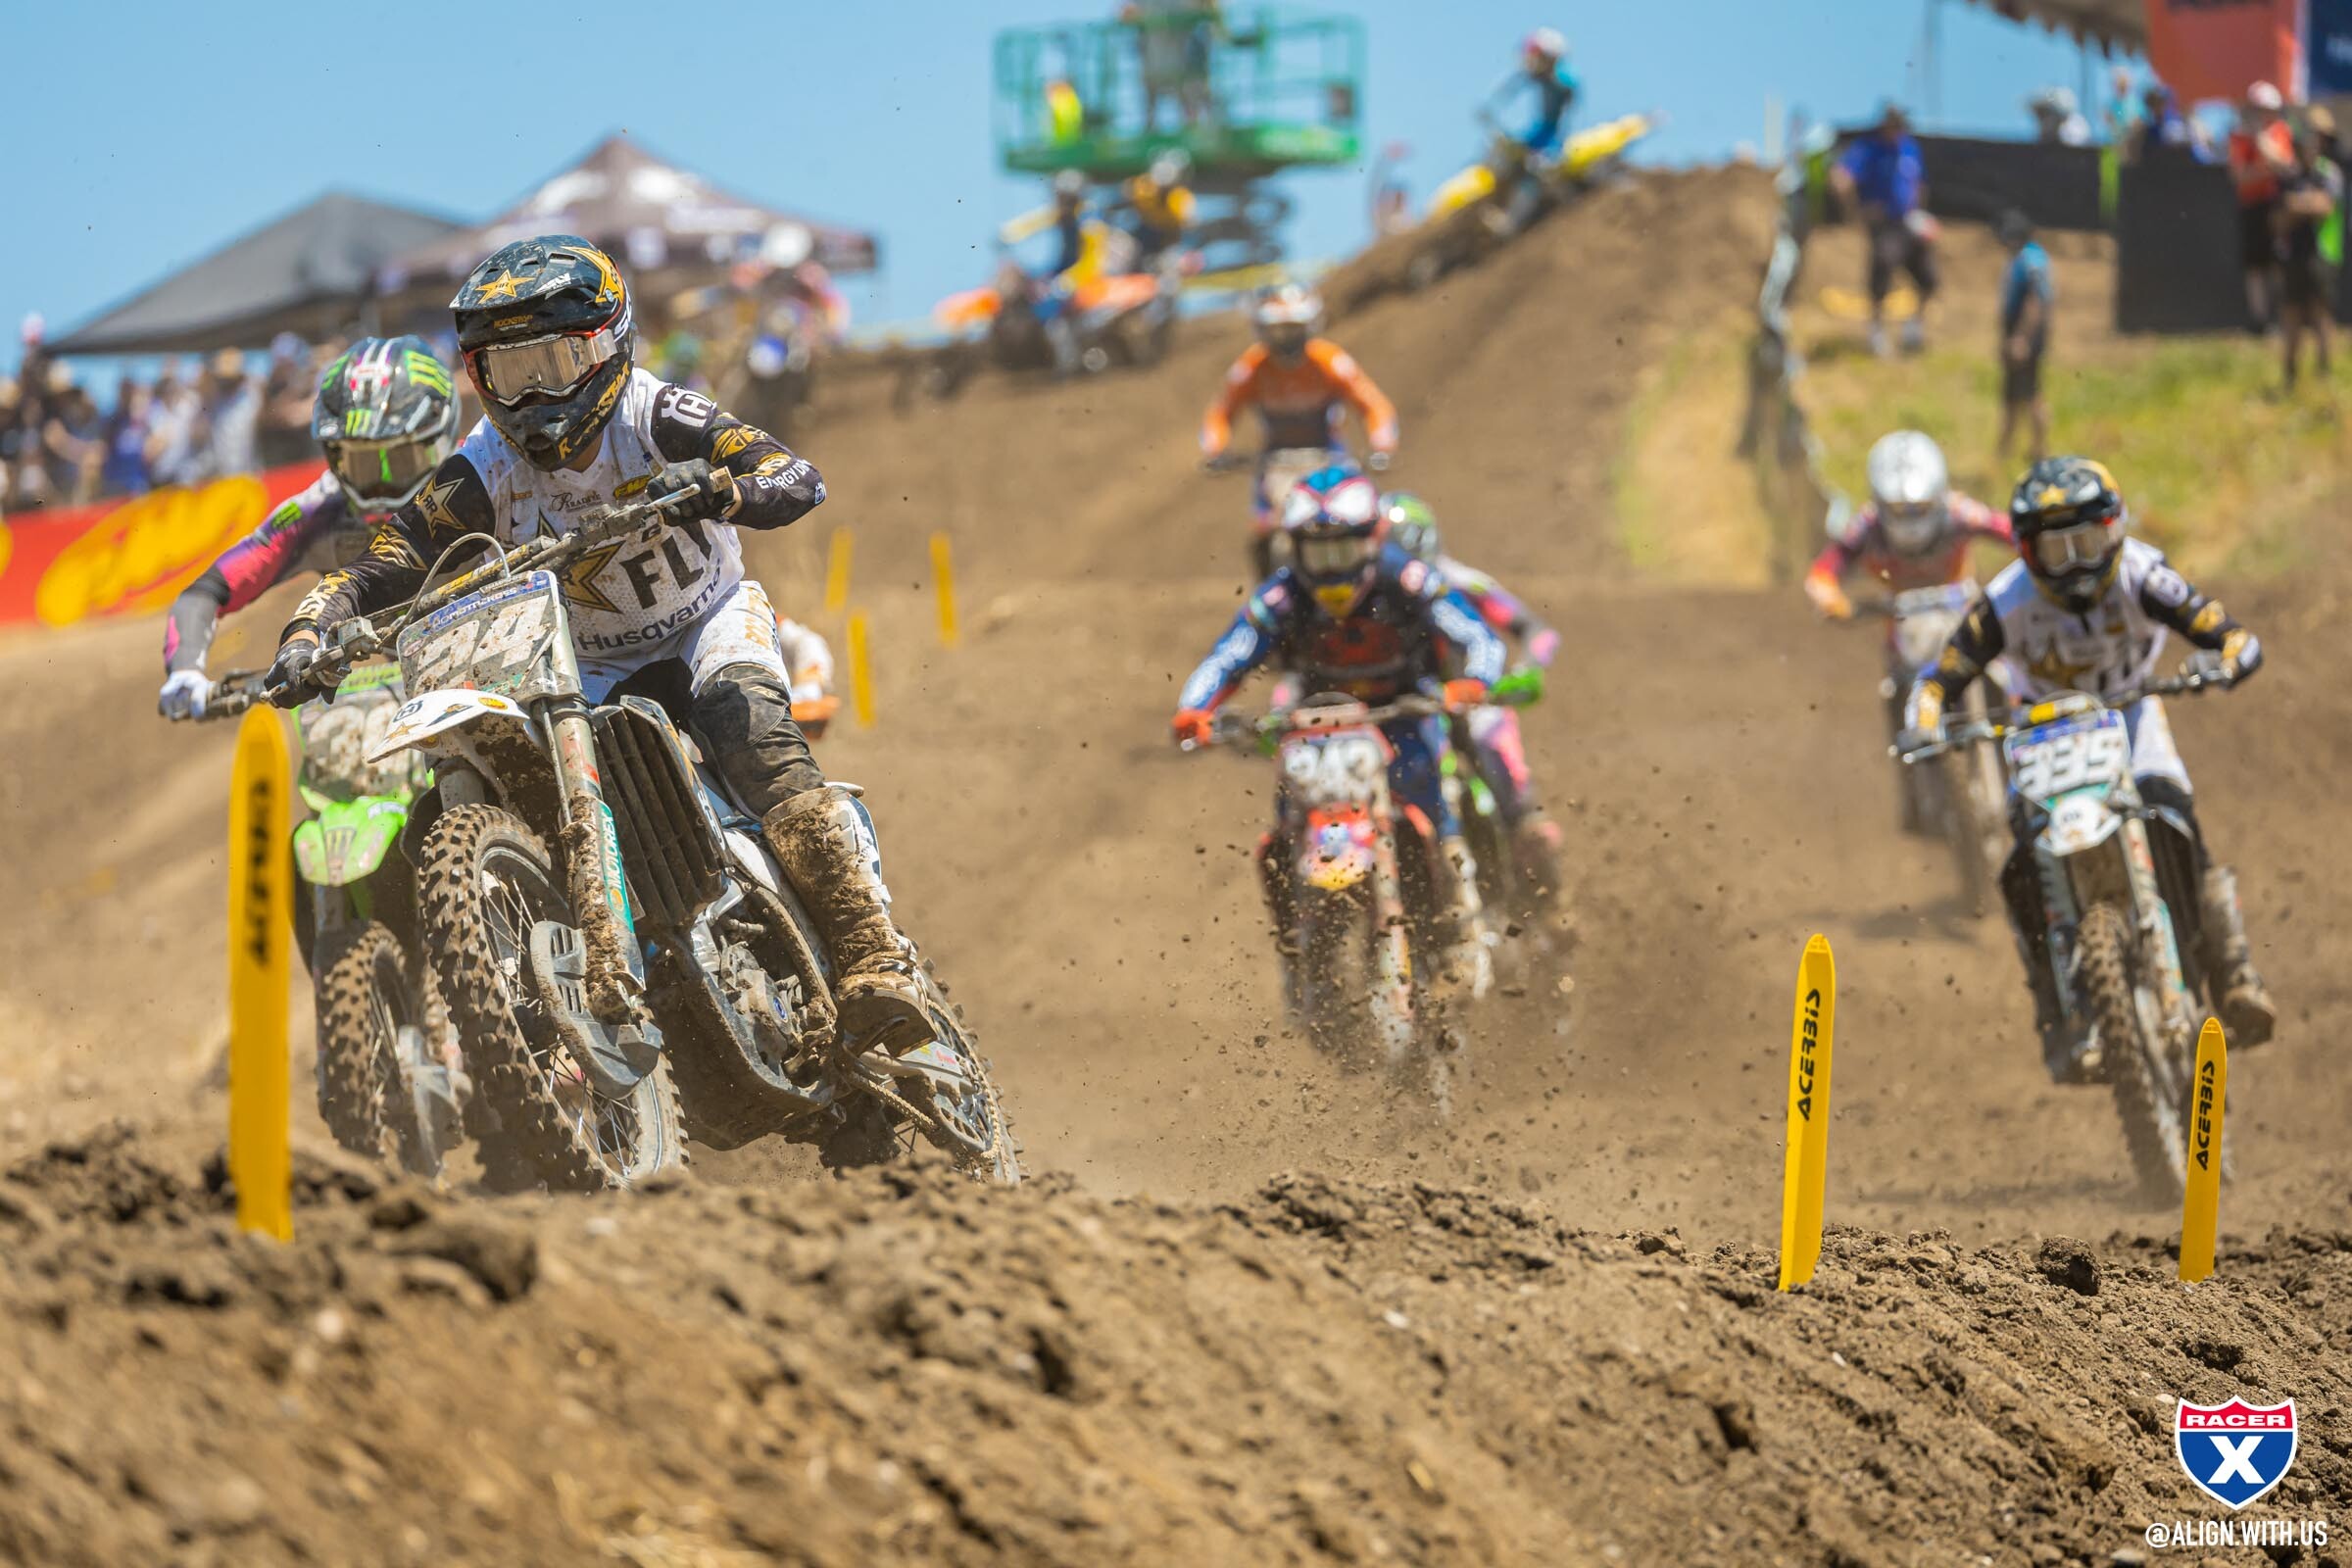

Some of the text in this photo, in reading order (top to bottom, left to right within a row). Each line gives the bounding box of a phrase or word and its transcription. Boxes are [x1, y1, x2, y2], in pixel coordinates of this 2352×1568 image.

[756, 467, 800, 490] ENRGY
[580, 564, 722, 652] Husqvarna
[2016, 731, 2125, 799] 335
[601, 812, 623, 890] MOTOREX
[1797, 988, 1821, 1122] ACERBIS
[2196, 1060, 2215, 1171] ACERBIS
